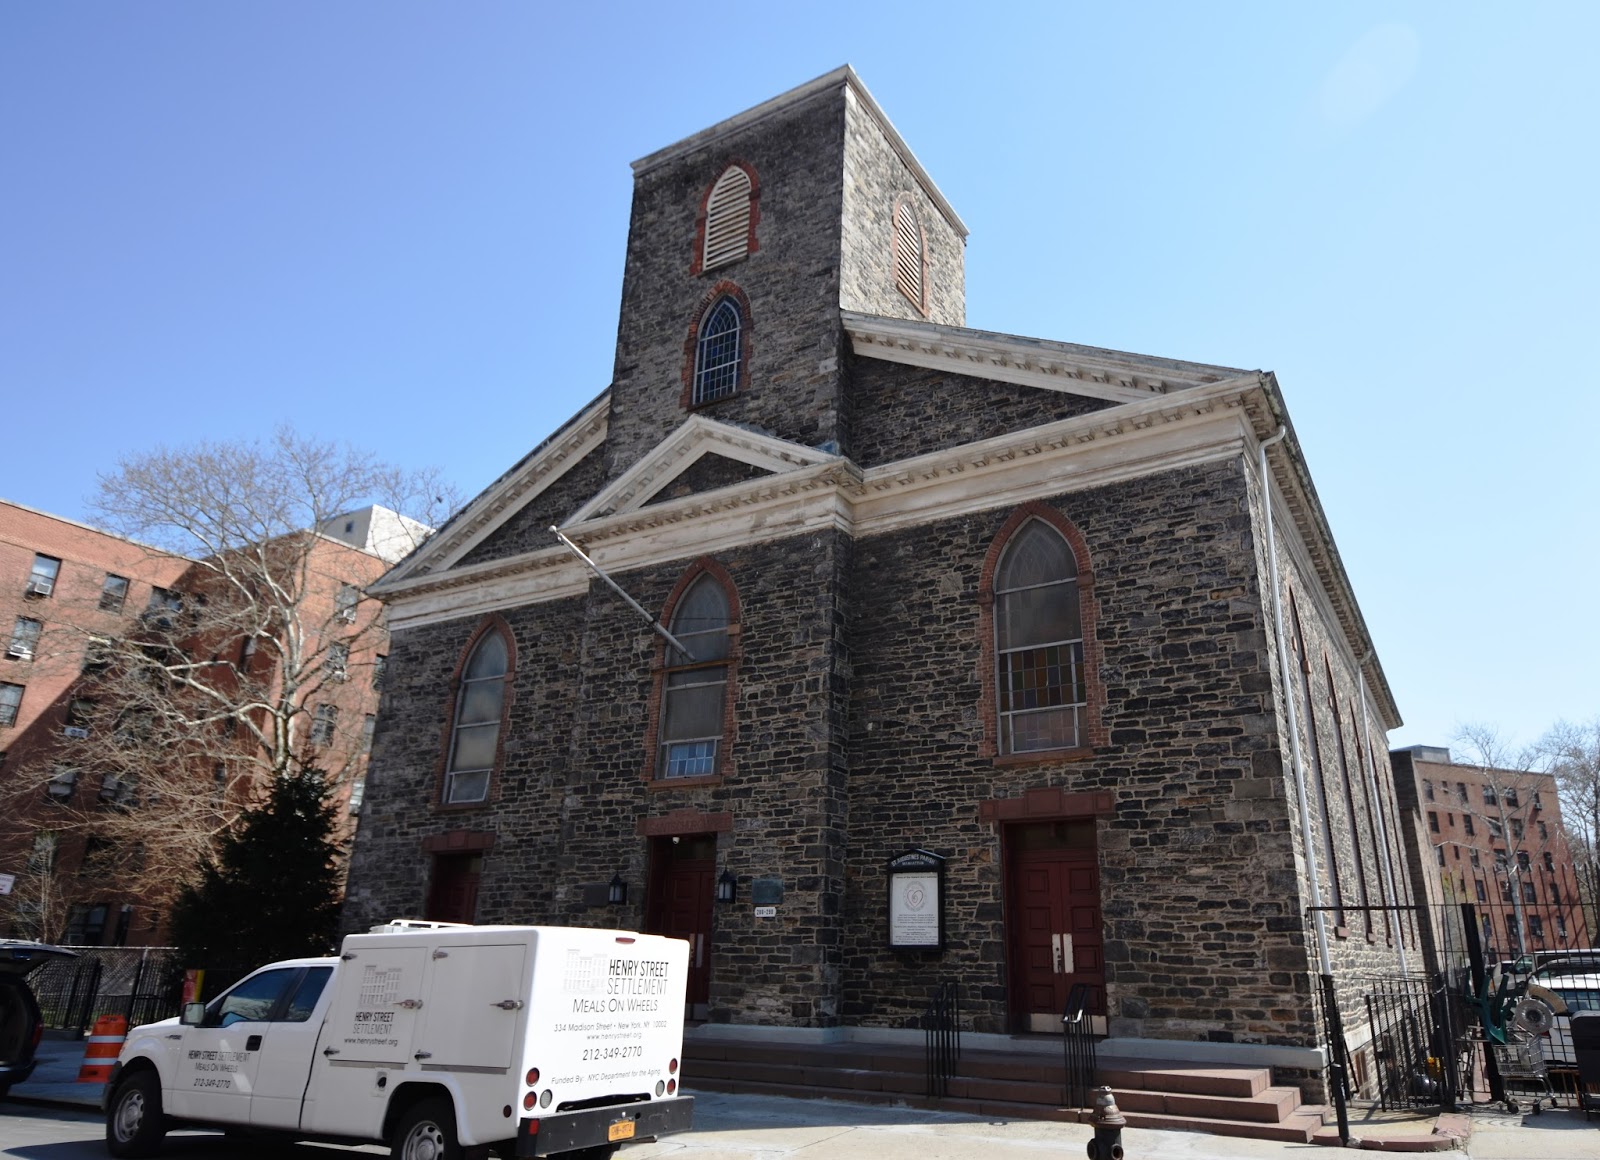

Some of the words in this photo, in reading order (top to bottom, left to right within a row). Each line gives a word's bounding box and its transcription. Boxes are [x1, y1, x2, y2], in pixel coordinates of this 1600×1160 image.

[609, 959, 639, 976] HENRY
[640, 960, 669, 977] STREET
[607, 977, 668, 995] SETTLEMENT
[572, 999, 606, 1013] MEALS
[627, 998, 658, 1012] WHEELS
[355, 1012, 373, 1022] HENRY
[373, 1012, 395, 1022] STREET
[353, 1023, 393, 1034] SETTLEMENT
[568, 1023, 595, 1032] Madison
[596, 1022, 613, 1031] Street
[618, 1022, 629, 1030] New
[344, 1038, 398, 1047] www.henrystreet.org
[201, 1050, 218, 1061] STREET
[582, 1046, 643, 1061] 212-349-2770
[551, 1076, 575, 1084] Funded
[587, 1073, 600, 1081] NYC
[600, 1071, 631, 1080] Department
[647, 1068, 661, 1077] Aging
[193, 1078, 231, 1089] 212-349-2770
